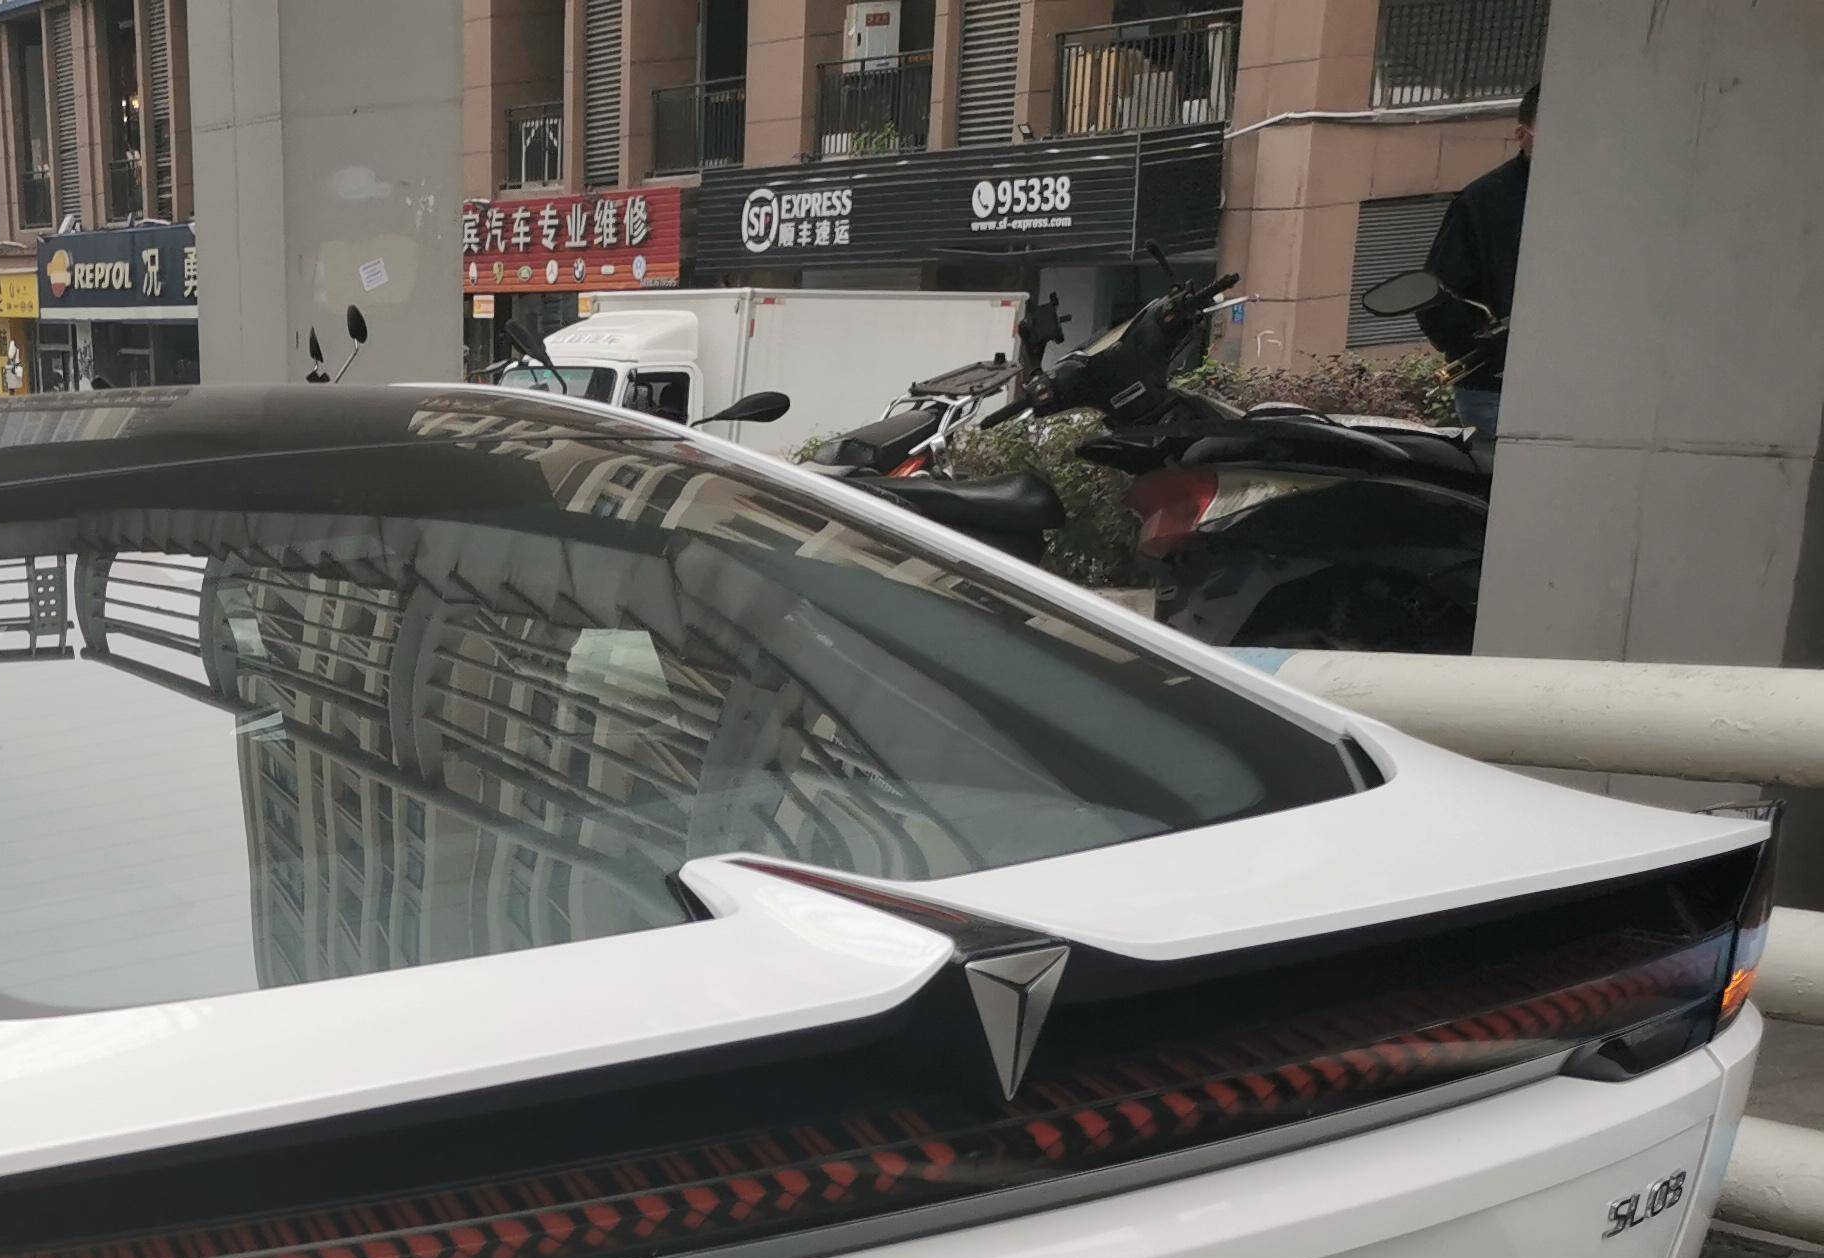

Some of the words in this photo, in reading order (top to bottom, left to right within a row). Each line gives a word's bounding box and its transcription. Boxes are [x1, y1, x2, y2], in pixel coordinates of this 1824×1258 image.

[780, 189, 852, 219] EXPRESS
[997, 176, 1071, 214] 95338
[462, 195, 650, 254] 宾汽车专业维修
[778, 219, 850, 247] 顺丰速运
[970, 217, 1072, 231] www.sf-express.com
[74, 261, 133, 290] REPSOL
[1601, 1168, 1687, 1240] SL03
